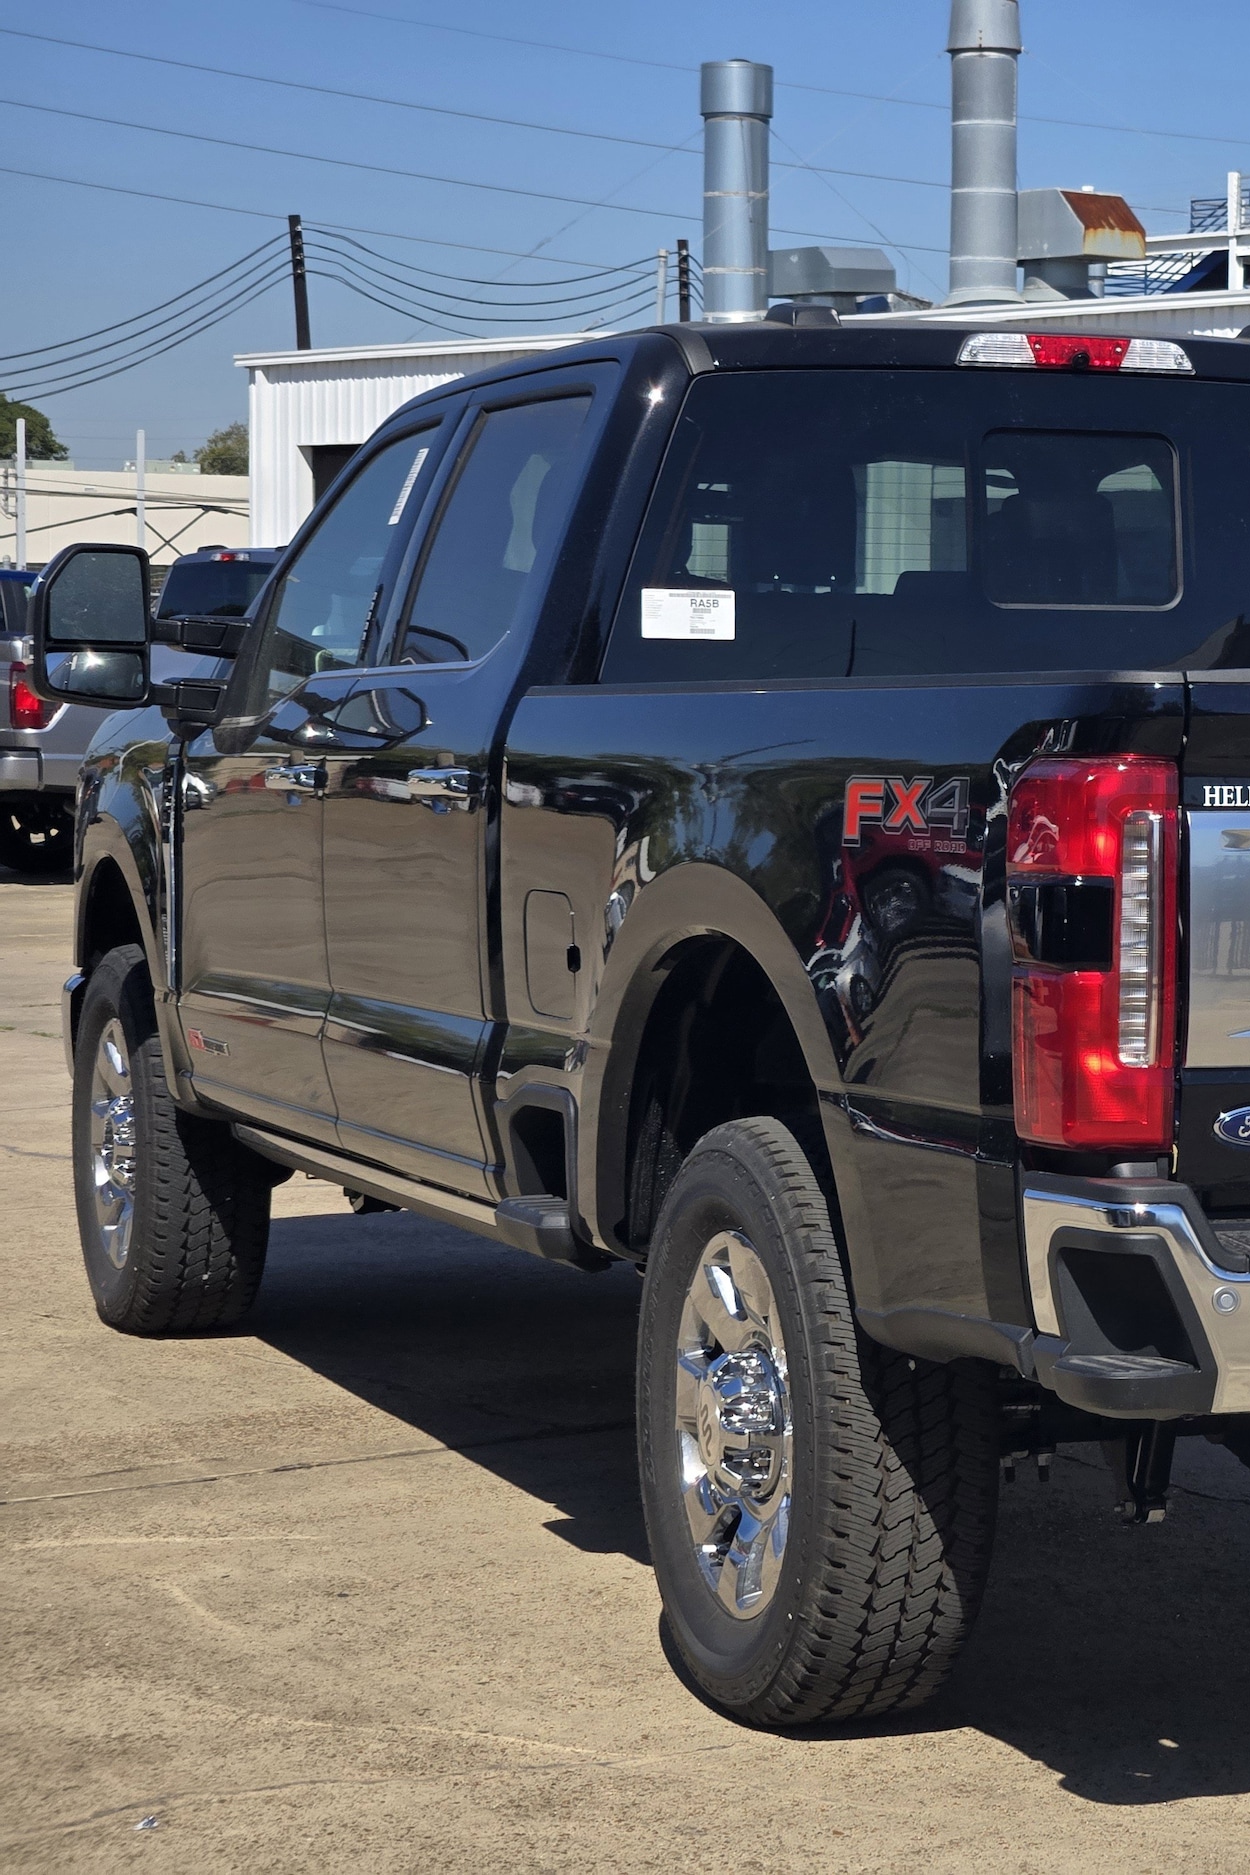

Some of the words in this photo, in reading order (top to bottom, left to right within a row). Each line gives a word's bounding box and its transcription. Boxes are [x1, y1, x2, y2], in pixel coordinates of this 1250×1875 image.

[842, 774, 971, 848] FX4
[908, 839, 931, 851] OFF
[934, 839, 967, 854] ROAD
